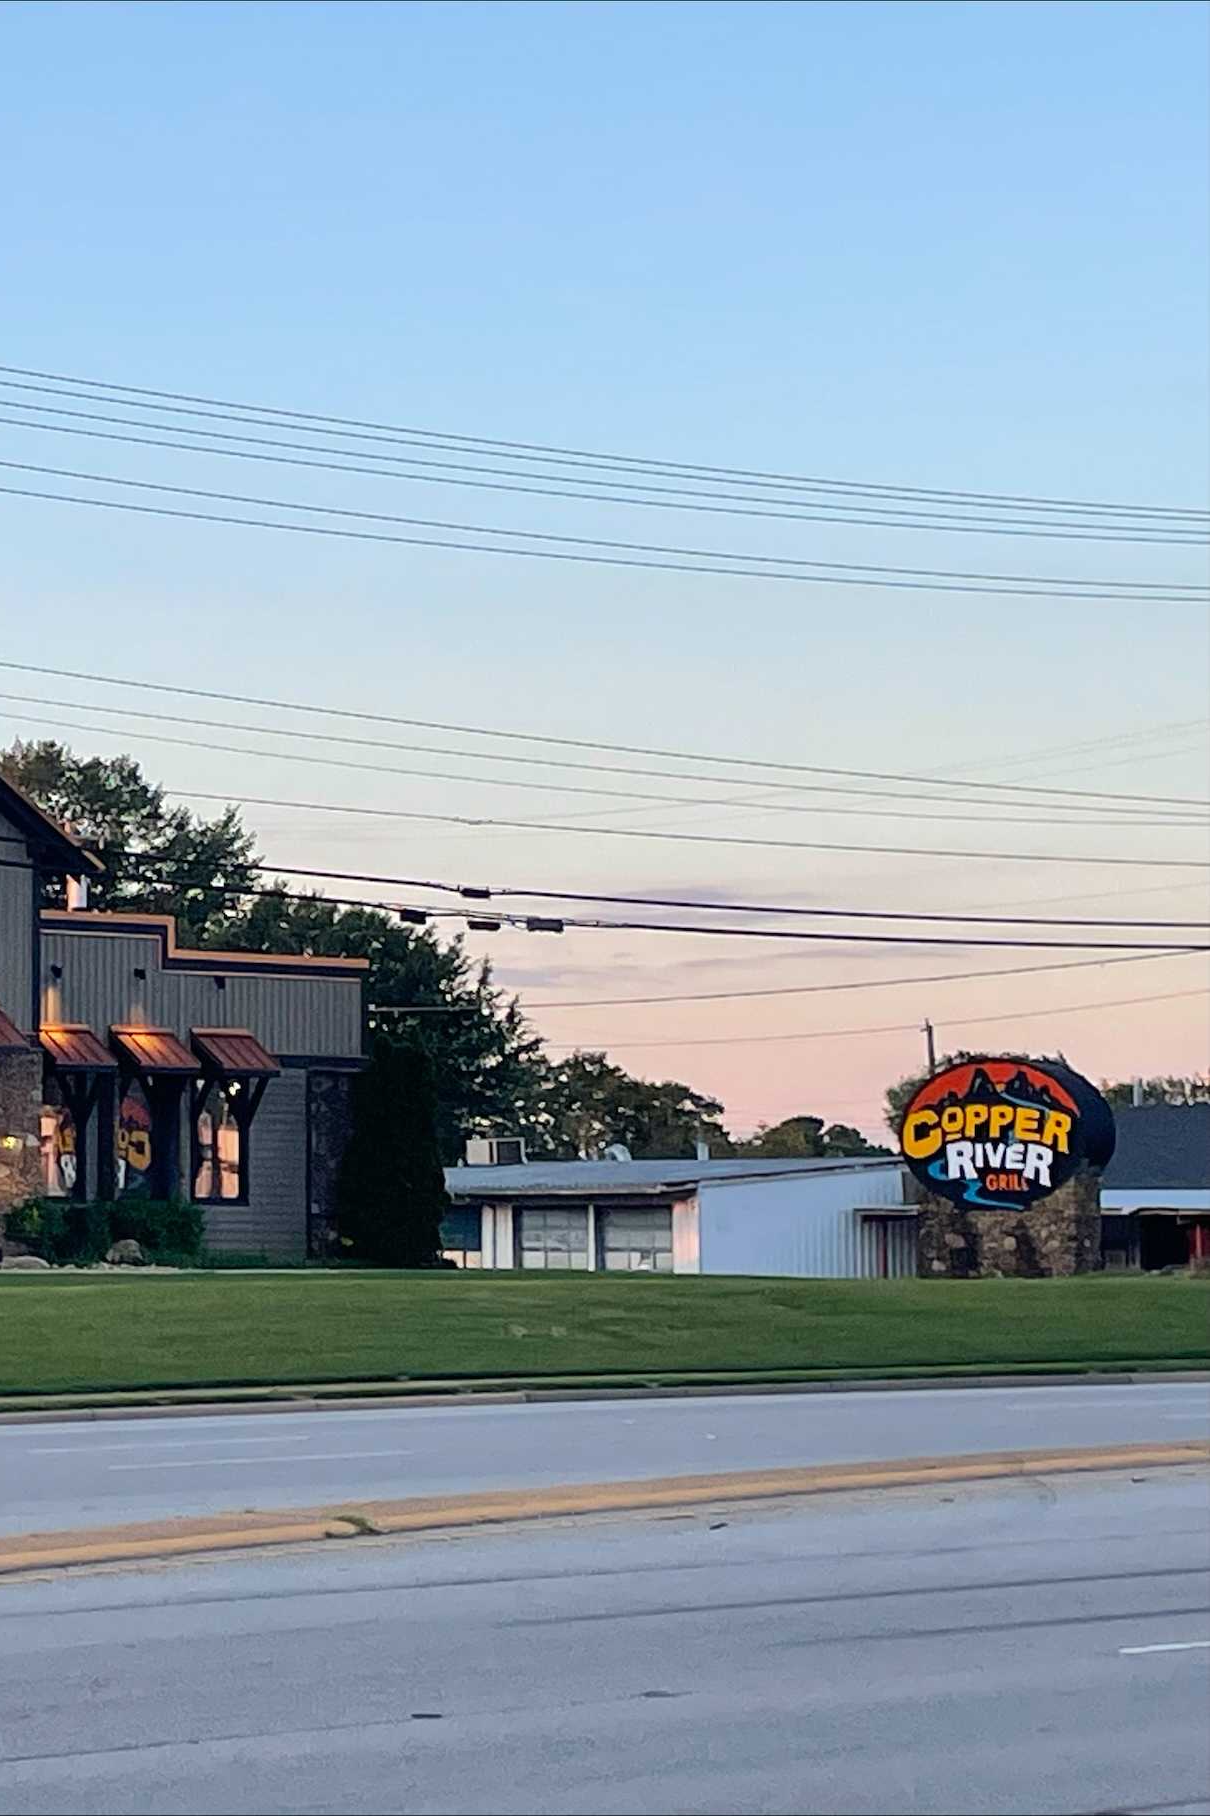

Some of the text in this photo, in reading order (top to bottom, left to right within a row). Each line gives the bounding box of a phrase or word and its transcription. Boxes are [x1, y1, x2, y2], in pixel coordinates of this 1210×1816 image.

[903, 1103, 1072, 1159] COPPER
[945, 1140, 1053, 1187] RIVER
[985, 1173, 1030, 1192] GRILL
